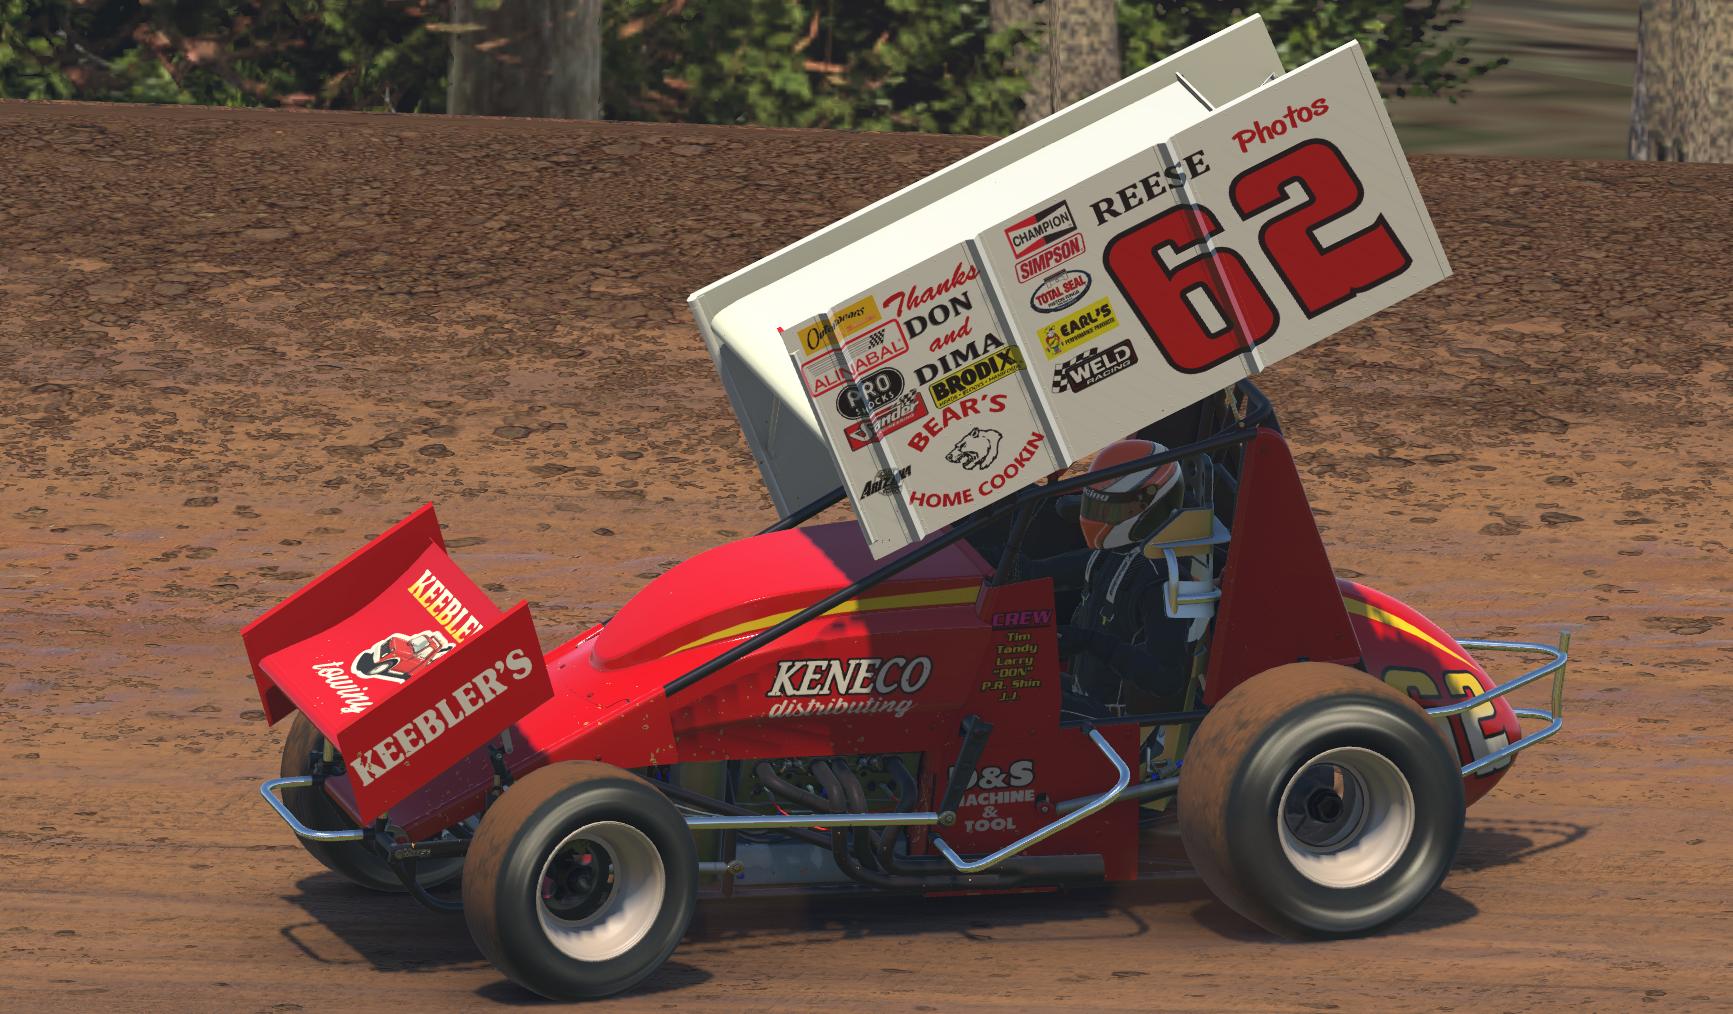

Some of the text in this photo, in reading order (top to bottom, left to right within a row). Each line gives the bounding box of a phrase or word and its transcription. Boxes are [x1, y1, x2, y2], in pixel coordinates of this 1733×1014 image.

[1090, 97, 1329, 226] REESE Photos
[1012, 211, 1070, 248] CHAMPION
[1020, 236, 1083, 278] SIMPSON
[1102, 138, 1413, 375] 62
[883, 262, 980, 318] Thanks
[1036, 276, 1086, 306] TOTAL SEAL
[903, 291, 973, 340] DON
[929, 316, 973, 352] and
[1060, 304, 1112, 336] EARL'S
[814, 341, 904, 392] ALINABAL
[913, 332, 1004, 387] DIMA
[932, 348, 1017, 401] BRODIX
[1069, 345, 1131, 384] WELD
[1087, 360, 1131, 385] RACING
[847, 374, 891, 408] PRO
[908, 393, 1008, 452] BEAR'S
[908, 431, 1044, 508] HOME COOKIN
[407, 568, 484, 644] KEEBLE
[992, 609, 1052, 627] CREW
[1007, 632, 1031, 642] Tim
[767, 655, 932, 697] KENECO
[996, 656, 1034, 667] Larry
[312, 660, 373, 714] towing
[768, 697, 913, 718] distributing
[350, 648, 533, 787] KEEBLER'S
[964, 817, 1017, 833] TOOL
[982, 805, 998, 818] &
